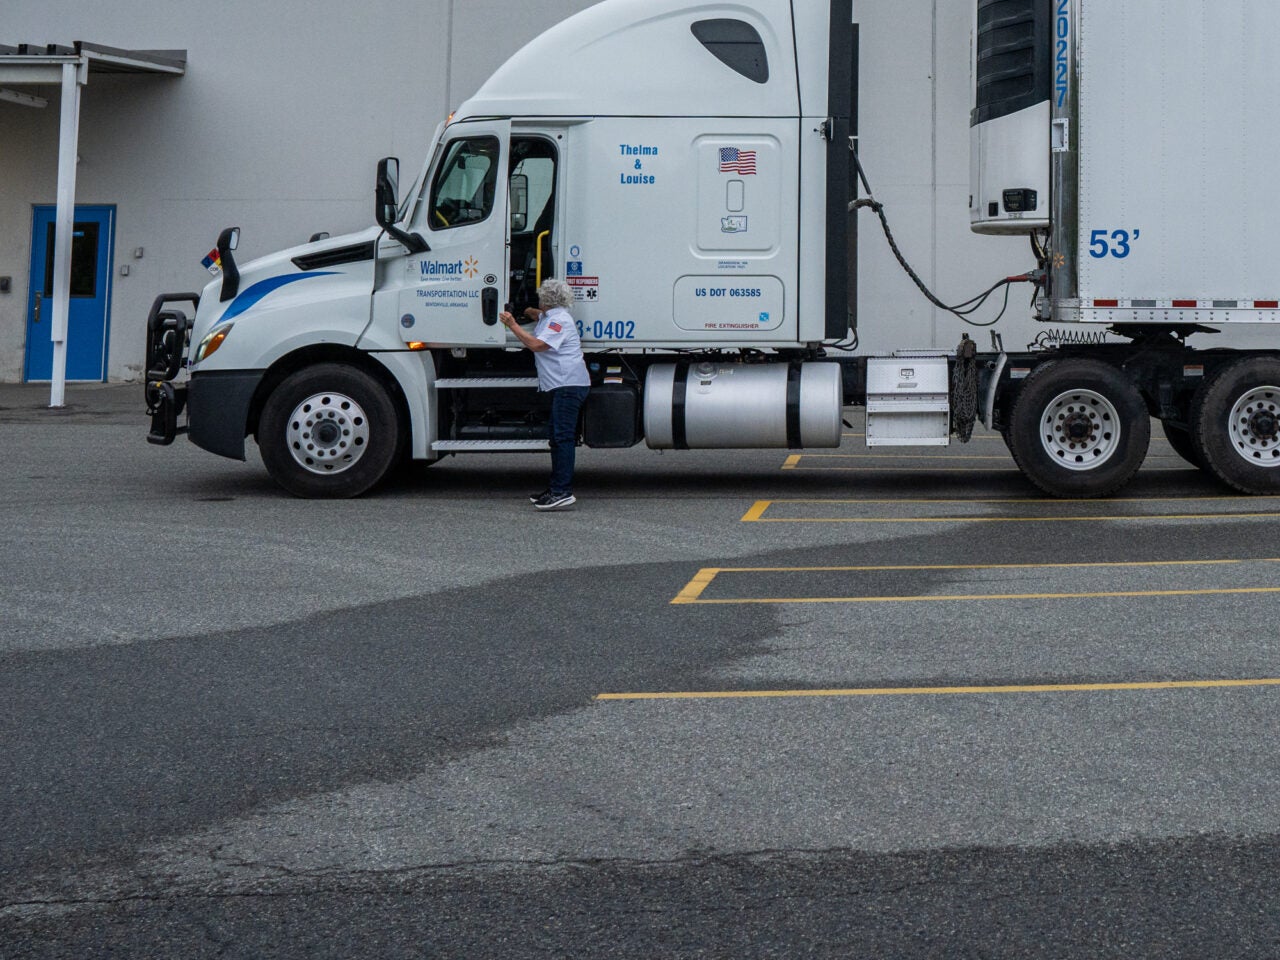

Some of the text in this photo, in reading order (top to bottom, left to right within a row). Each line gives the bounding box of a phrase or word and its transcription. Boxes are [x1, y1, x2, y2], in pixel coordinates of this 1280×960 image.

[619, 144, 658, 155] Thelma
[634, 158, 642, 170] &
[620, 173, 655, 184] Louise
[1089, 229, 1140, 259] 53'
[420, 260, 463, 275] Walmart
[416, 290, 479, 298] TRANSPORTATION LLC
[695, 288, 761, 298] US DOT 063585
